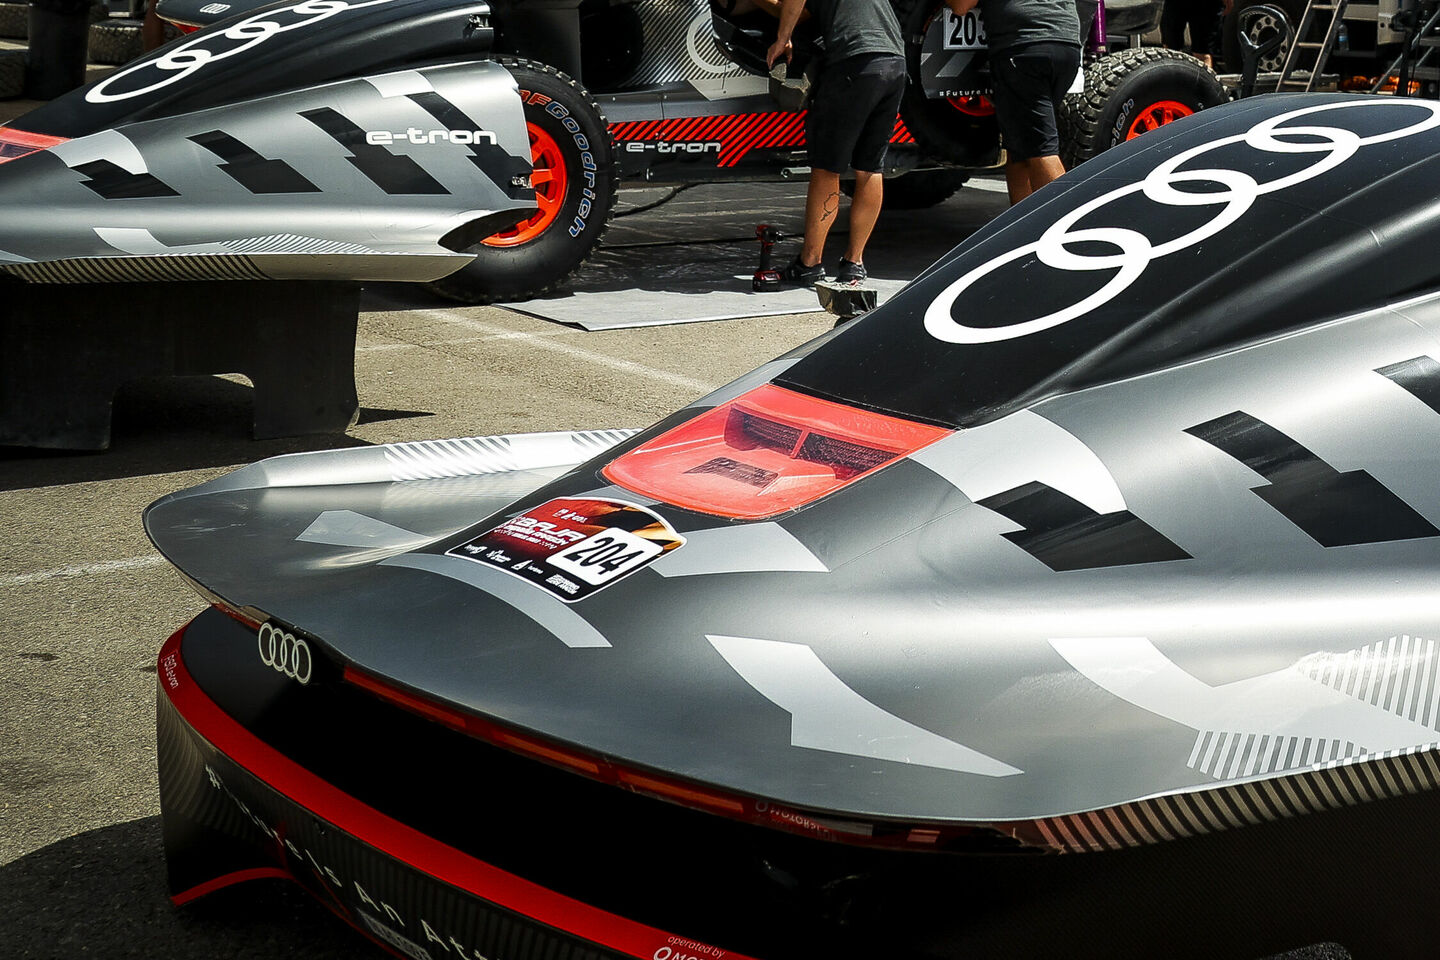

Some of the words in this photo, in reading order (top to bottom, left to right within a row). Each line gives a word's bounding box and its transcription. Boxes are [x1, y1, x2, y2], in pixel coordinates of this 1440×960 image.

[366, 127, 498, 145] e-tron
[626, 141, 721, 153] e-tron
[563, 537, 645, 575] 204
[667, 936, 713, 954] operated
[711, 947, 726, 958] by
